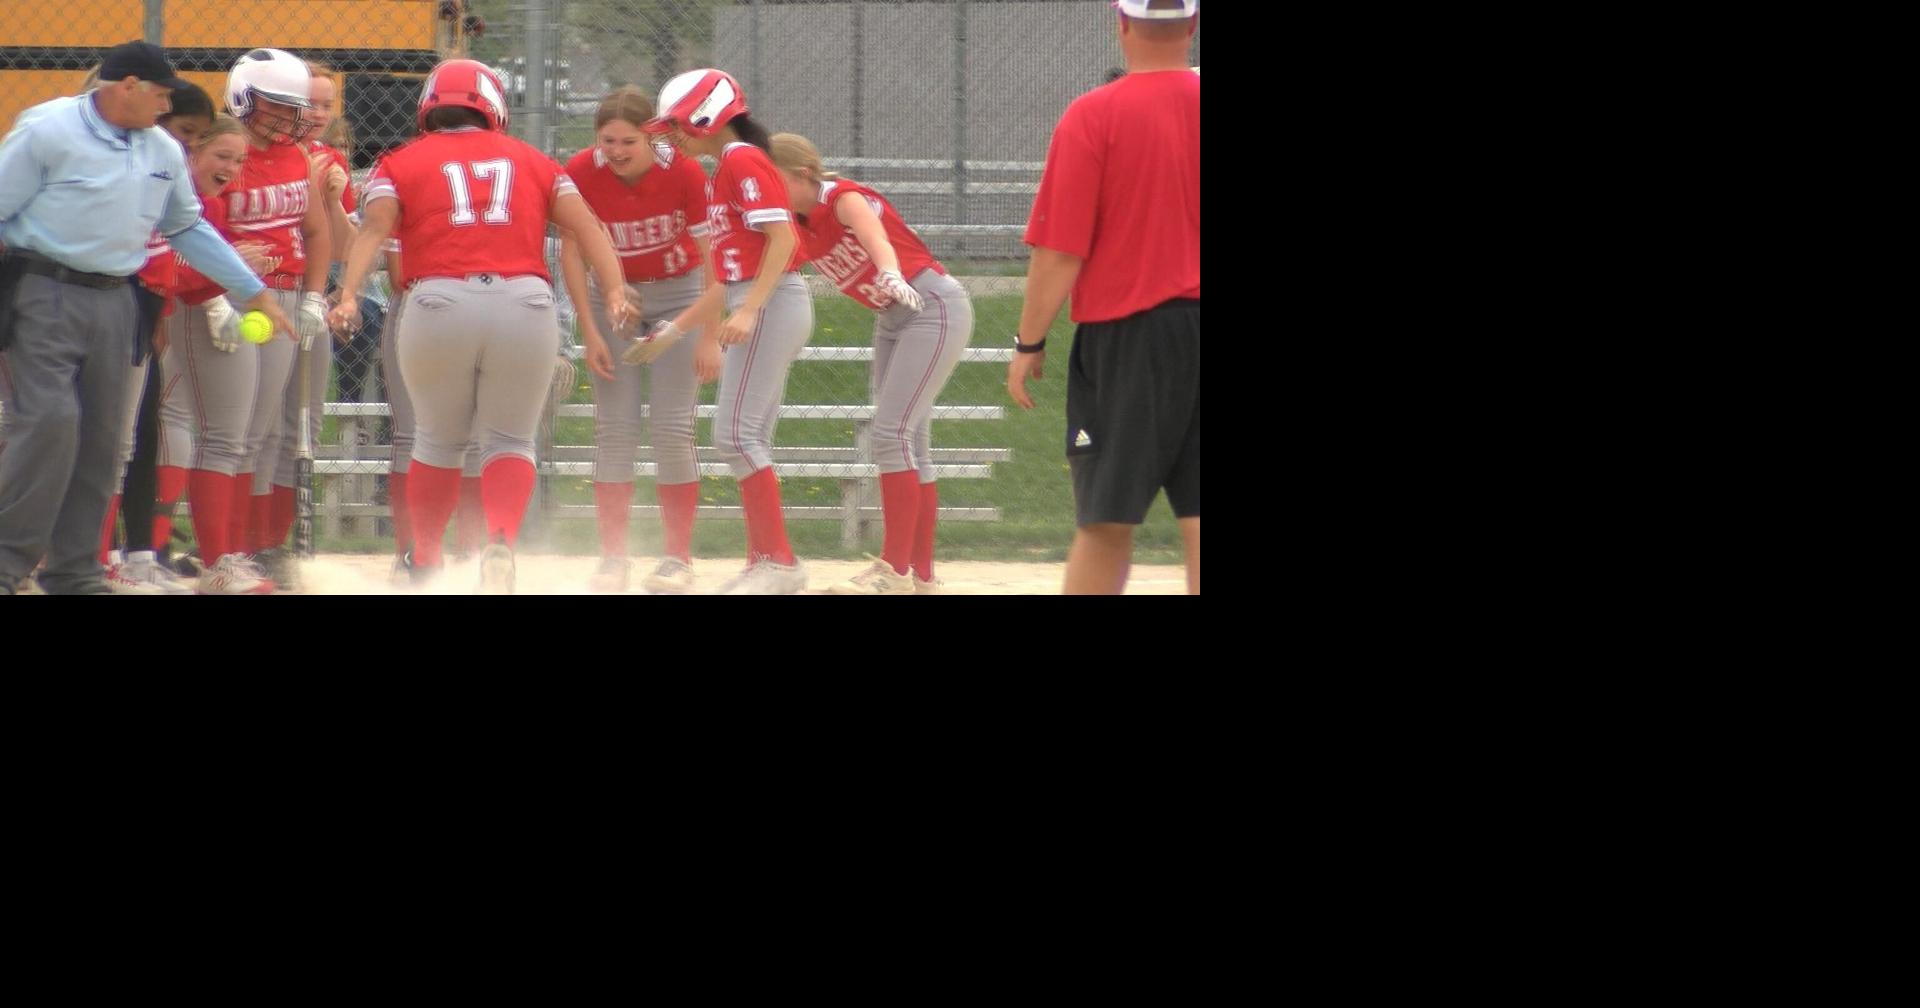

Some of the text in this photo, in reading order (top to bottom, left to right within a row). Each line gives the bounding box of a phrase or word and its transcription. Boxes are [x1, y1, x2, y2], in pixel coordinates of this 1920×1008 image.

[228, 179, 309, 221] RANGER
[440, 157, 515, 227] 17
[608, 209, 687, 250] NGERS
[722, 248, 742, 282] 5
[296, 487, 312, 559] EAST
